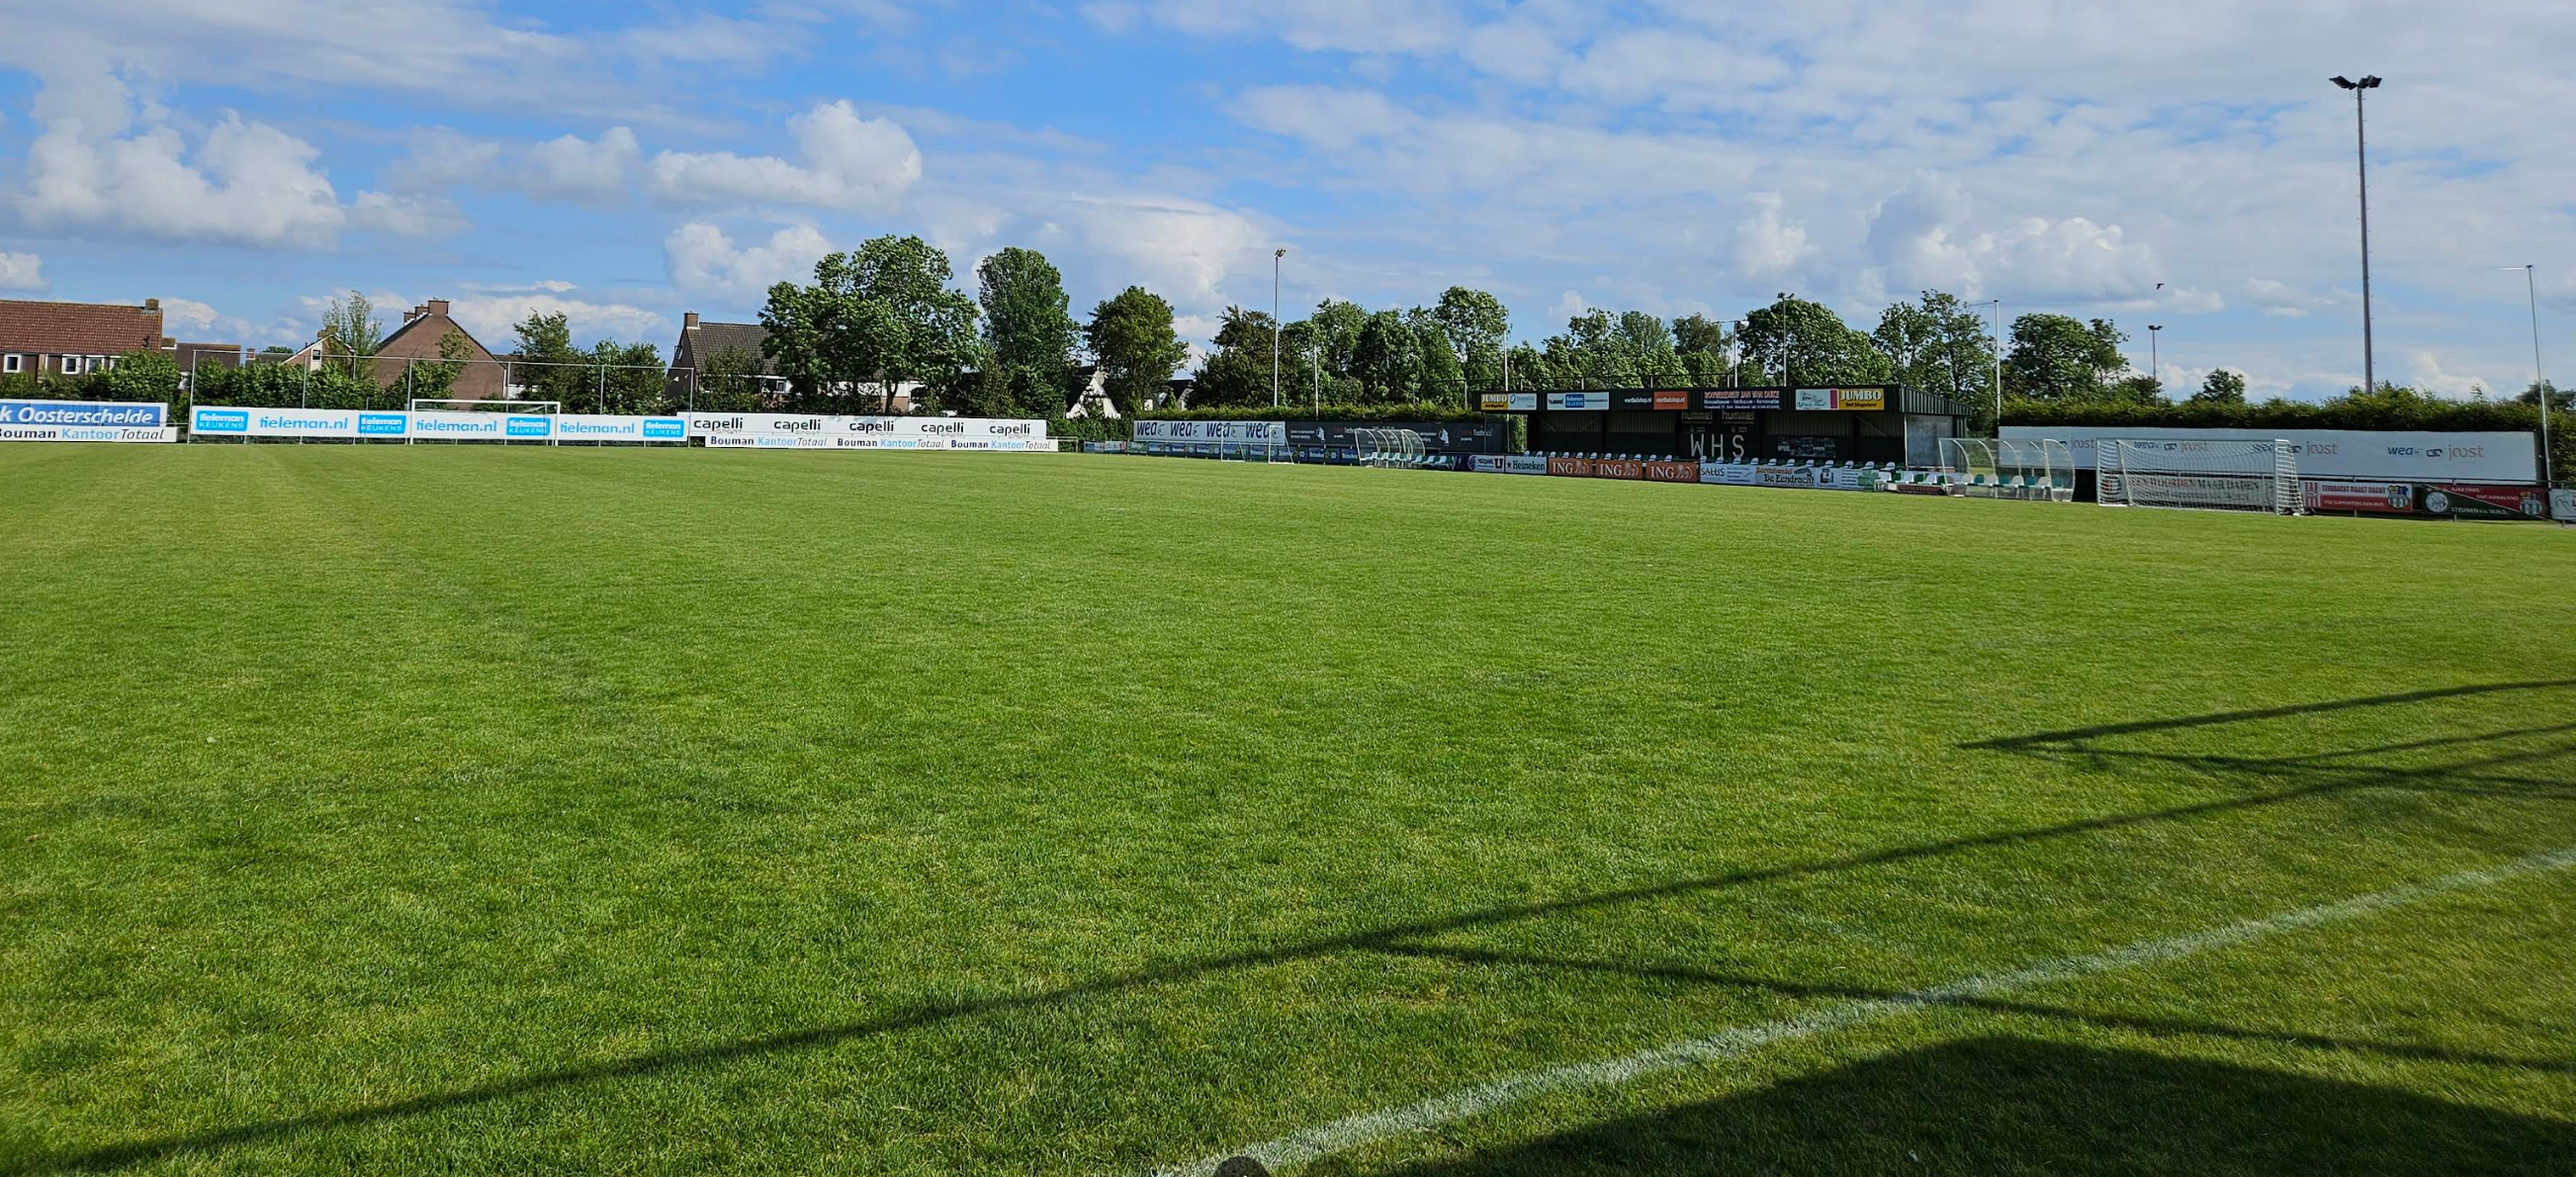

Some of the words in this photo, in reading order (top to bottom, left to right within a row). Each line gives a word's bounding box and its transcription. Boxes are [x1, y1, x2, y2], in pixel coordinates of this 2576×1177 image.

[1840, 390, 1882, 401] JUMBO
[18, 407, 153, 424] Oosterschelde
[200, 412, 245, 422] tieleman
[1681, 410, 1713, 420] hummel
[1722, 410, 1754, 420] hummel
[259, 416, 348, 430] tieleman.nl
[416, 419, 497, 432] tieleman.nl
[560, 421, 634, 434] tieleman.nl
[693, 417, 744, 431] capelli
[774, 418, 821, 432] capelli
[849, 420, 894, 435] capelli
[922, 421, 964, 435] capelli
[1136, 422, 1158, 436] wea
[0, 429, 56, 438] ouman
[990, 423, 1030, 436] capelli
[1171, 422, 1192, 437] wea
[711, 436, 754, 445] Bouman
[838, 438, 877, 447] Bouman
[951, 439, 988, 449] Bouman
[2306, 441, 2339, 456] joost
[2387, 446, 2414, 456] wea
[2448, 444, 2483, 460] joost
[1512, 459, 1546, 471] Heineken
[1553, 462, 1573, 474] ING
[1600, 464, 1622, 476] ING
[1650, 466, 1674, 479] ING
[1701, 468, 1725, 477] SALUS
[1764, 474, 1774, 483] De
[1776, 474, 1815, 485] Eendracht
[2197, 479, 2226, 490] MAAR
[2227, 480, 2259, 491] DADEN
